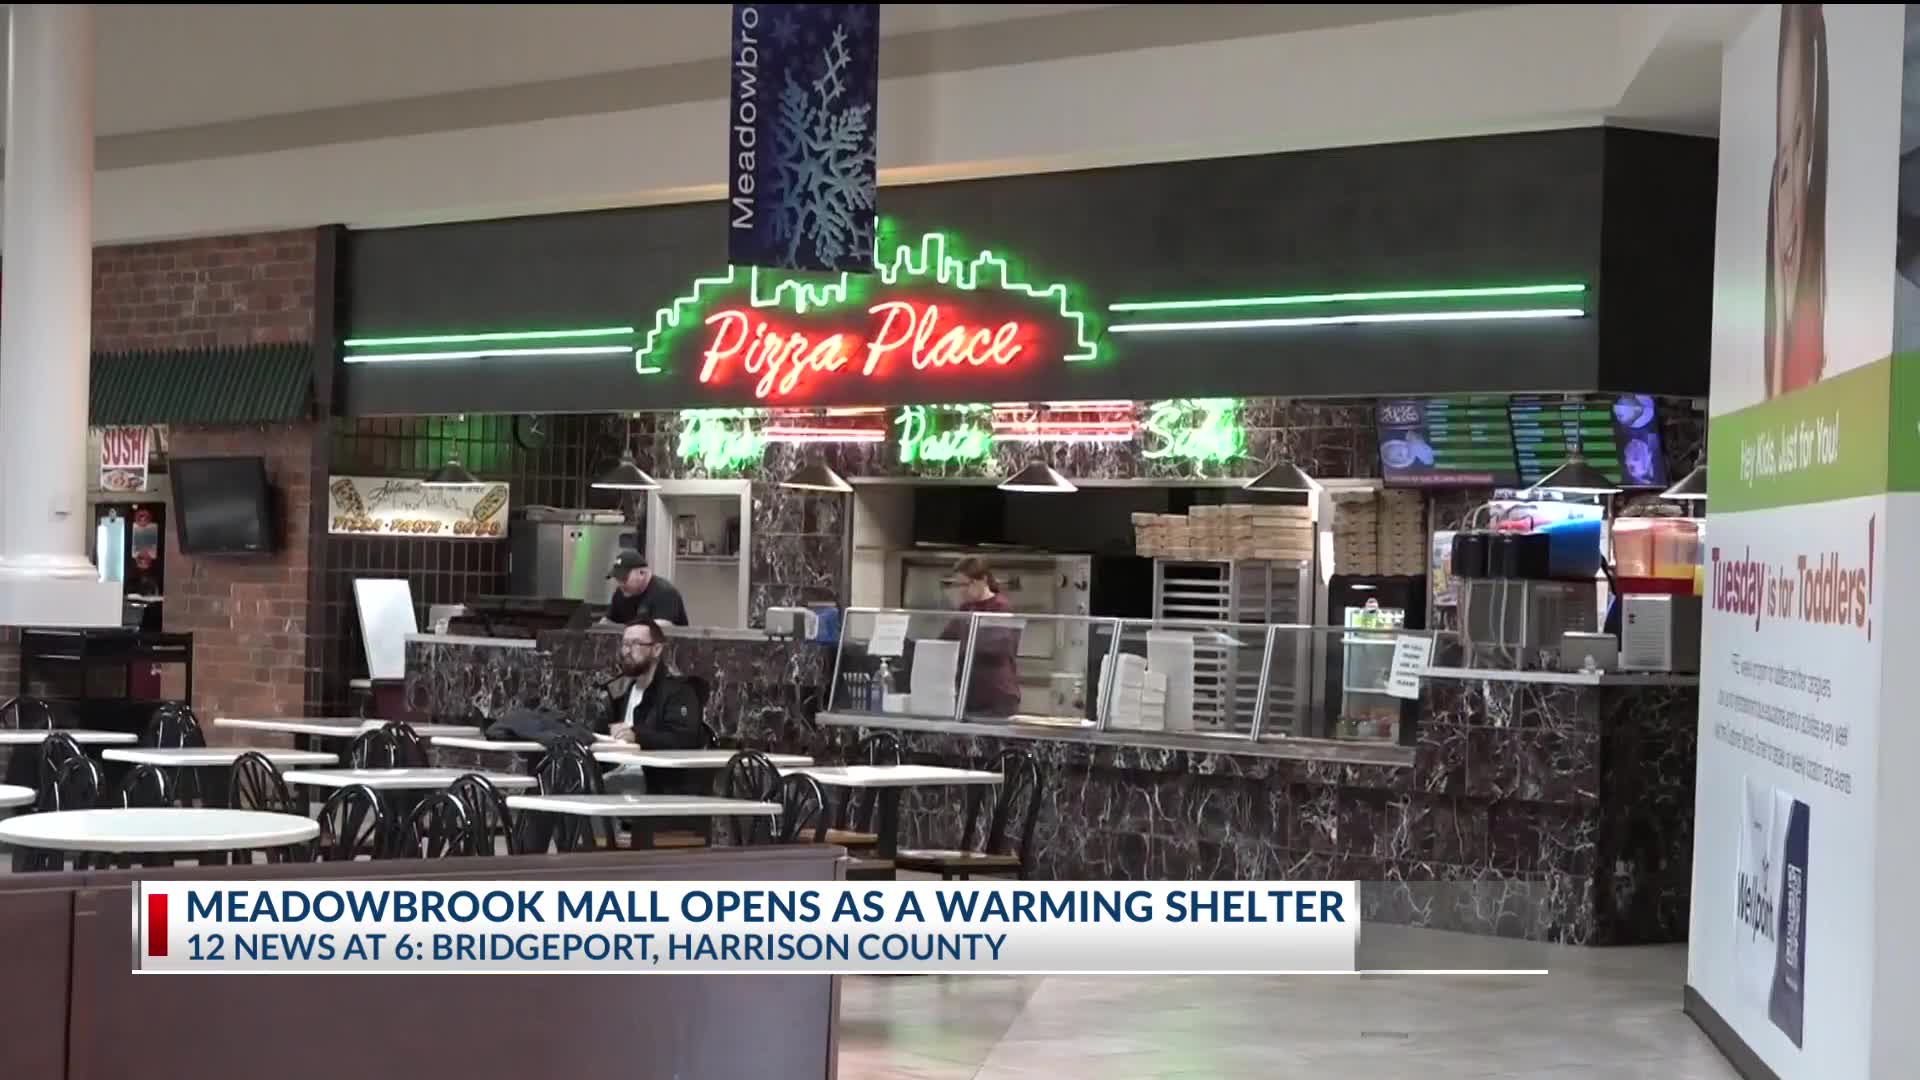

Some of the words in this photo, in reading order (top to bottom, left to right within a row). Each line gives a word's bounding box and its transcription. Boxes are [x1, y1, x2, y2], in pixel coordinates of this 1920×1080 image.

[732, 7, 759, 229] Meadowbro
[700, 309, 848, 398] Pizza
[863, 301, 1022, 377] Place
[102, 428, 146, 465] SUSHI
[1778, 424, 1799, 473] Just
[1800, 418, 1815, 469] for
[1816, 410, 1840, 465] You!
[1711, 546, 1765, 633] Tuesday
[1766, 565, 1777, 617] is
[1778, 566, 1794, 619] for
[1797, 512, 1876, 643] Toddlers!
